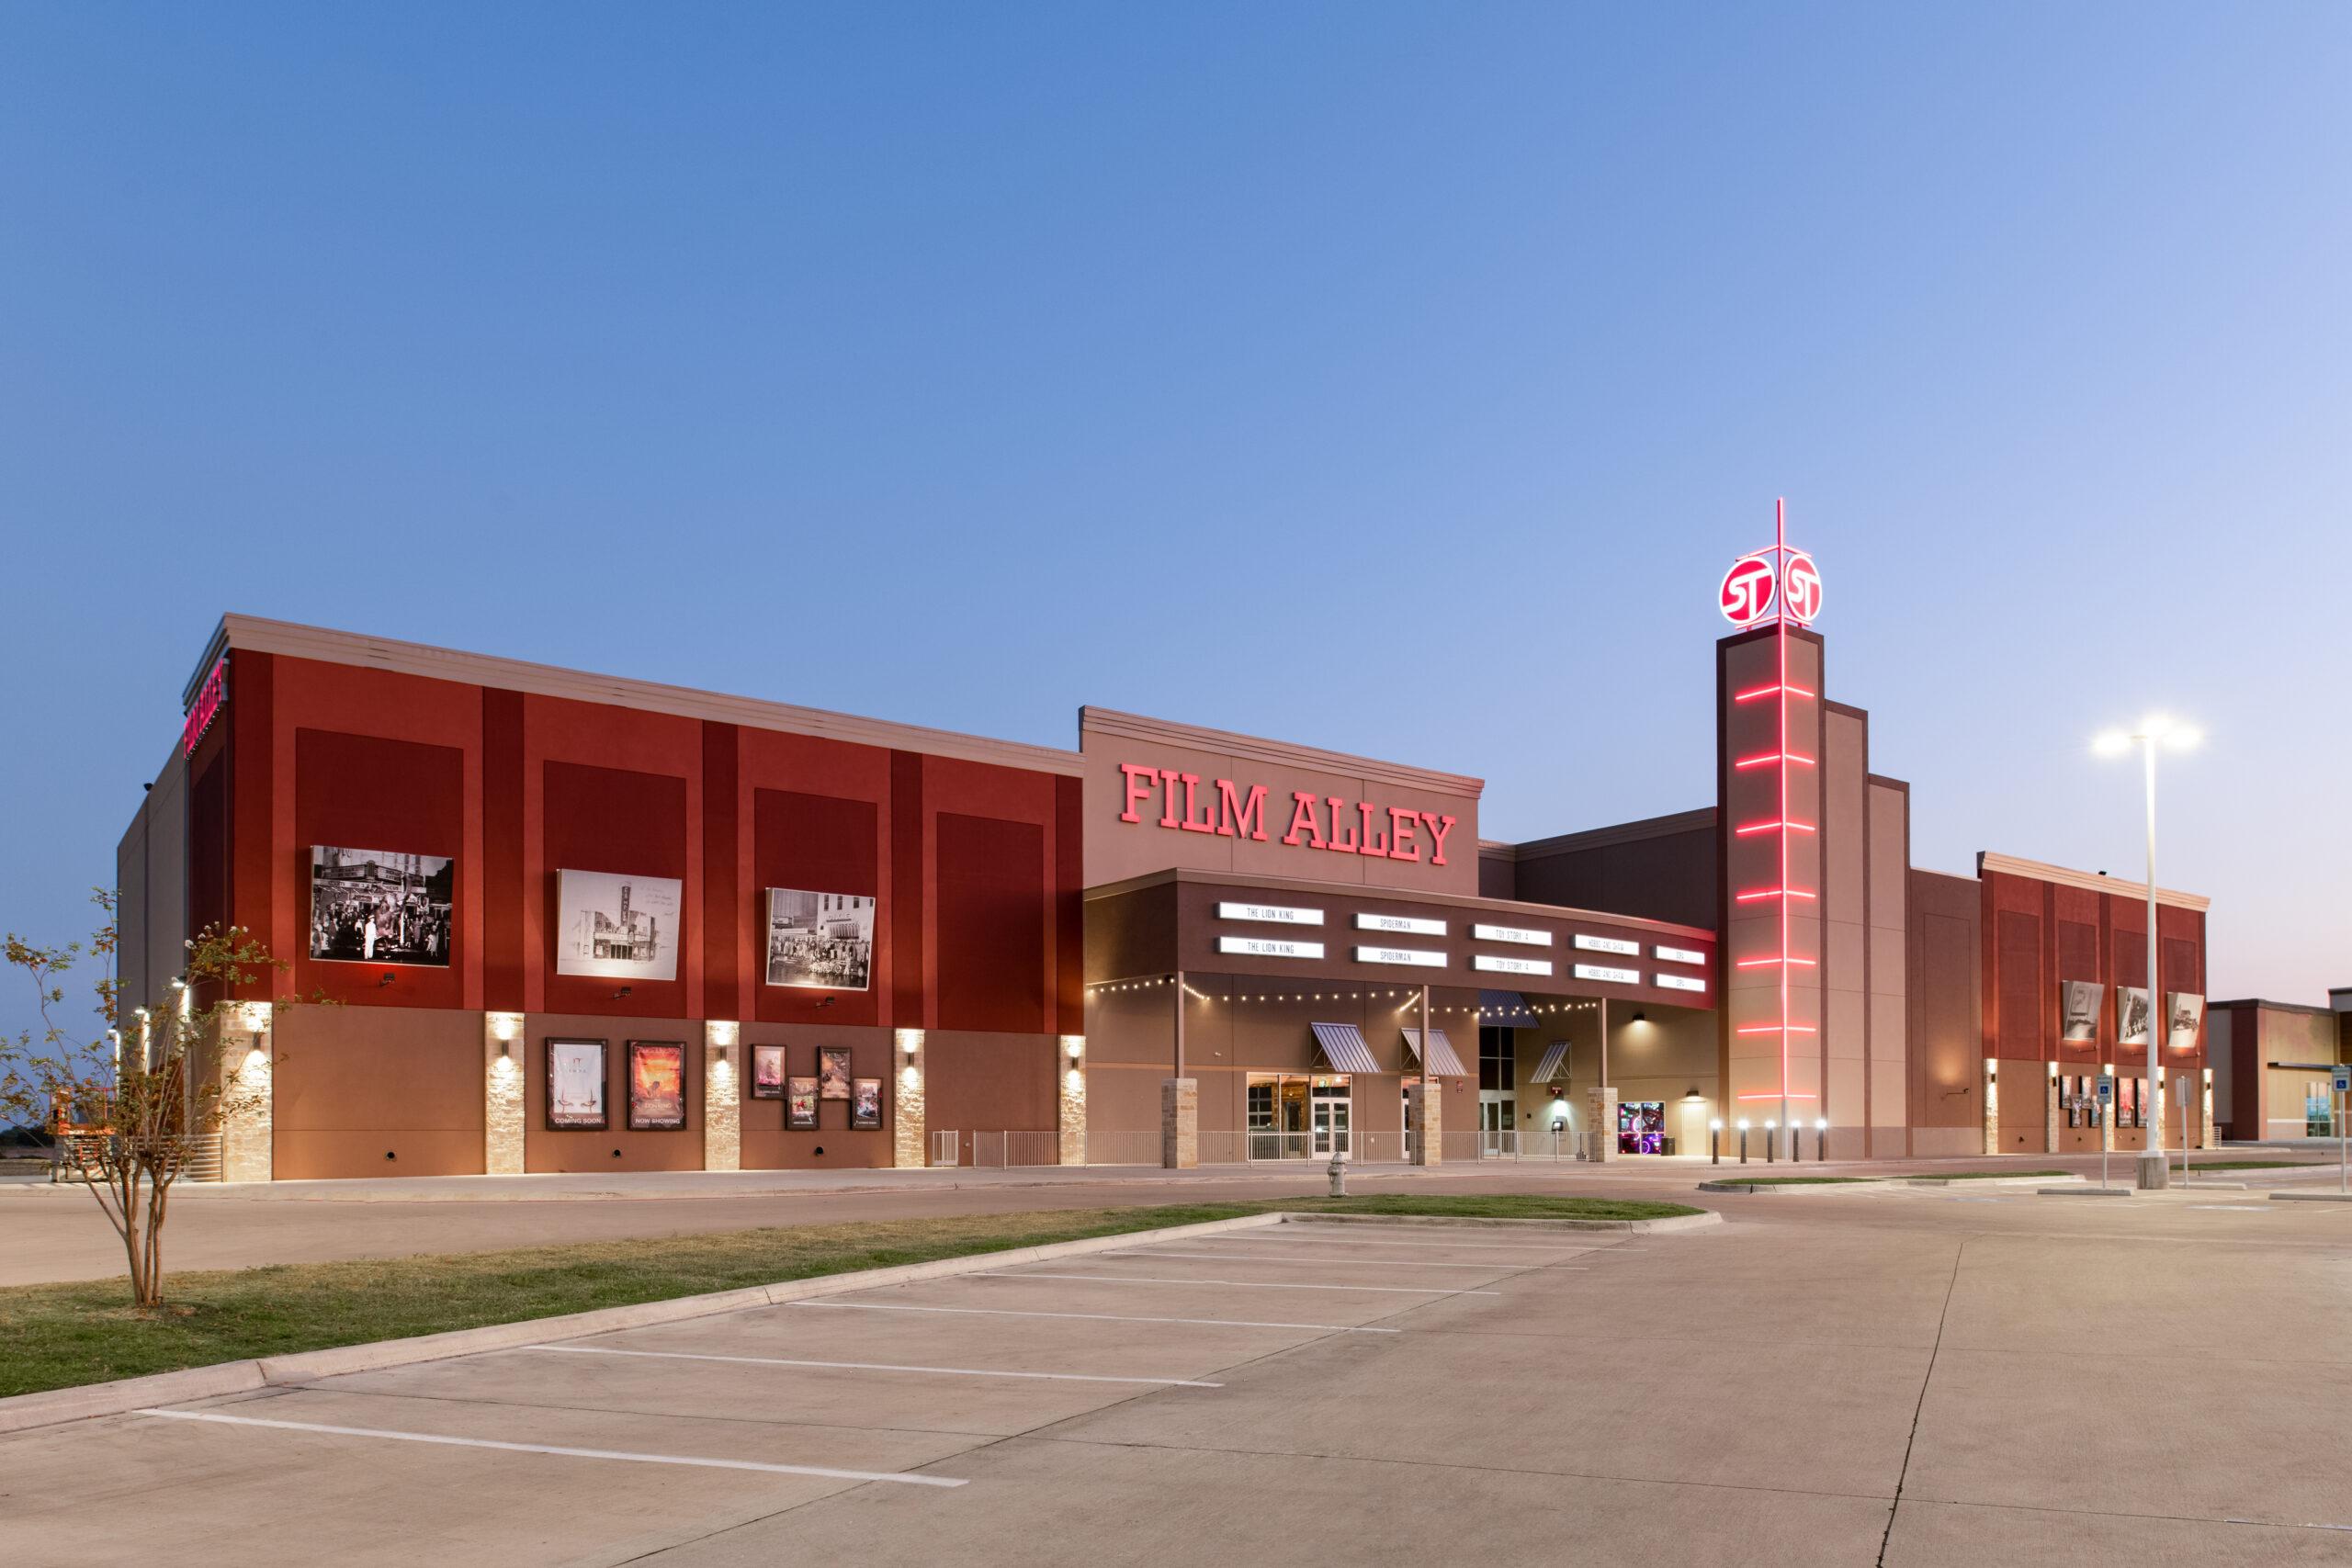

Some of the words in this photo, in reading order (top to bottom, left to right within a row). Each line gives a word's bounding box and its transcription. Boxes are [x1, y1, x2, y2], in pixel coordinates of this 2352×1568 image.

[1723, 567, 1773, 621] ST
[1787, 568, 1821, 621] ST
[1119, 763, 1269, 841] FILM
[1282, 792, 1456, 865] ALLEY
[1247, 908, 1258, 918] THE
[1261, 908, 1276, 919] LION
[1279, 910, 1294, 919] KING
[1380, 919, 1411, 930] SPIDERMAN
[1248, 942, 1259, 952] THE
[1261, 943, 1276, 953] LION
[1279, 944, 1295, 953] KING
[1380, 951, 1411, 962] SPIDERMAN
